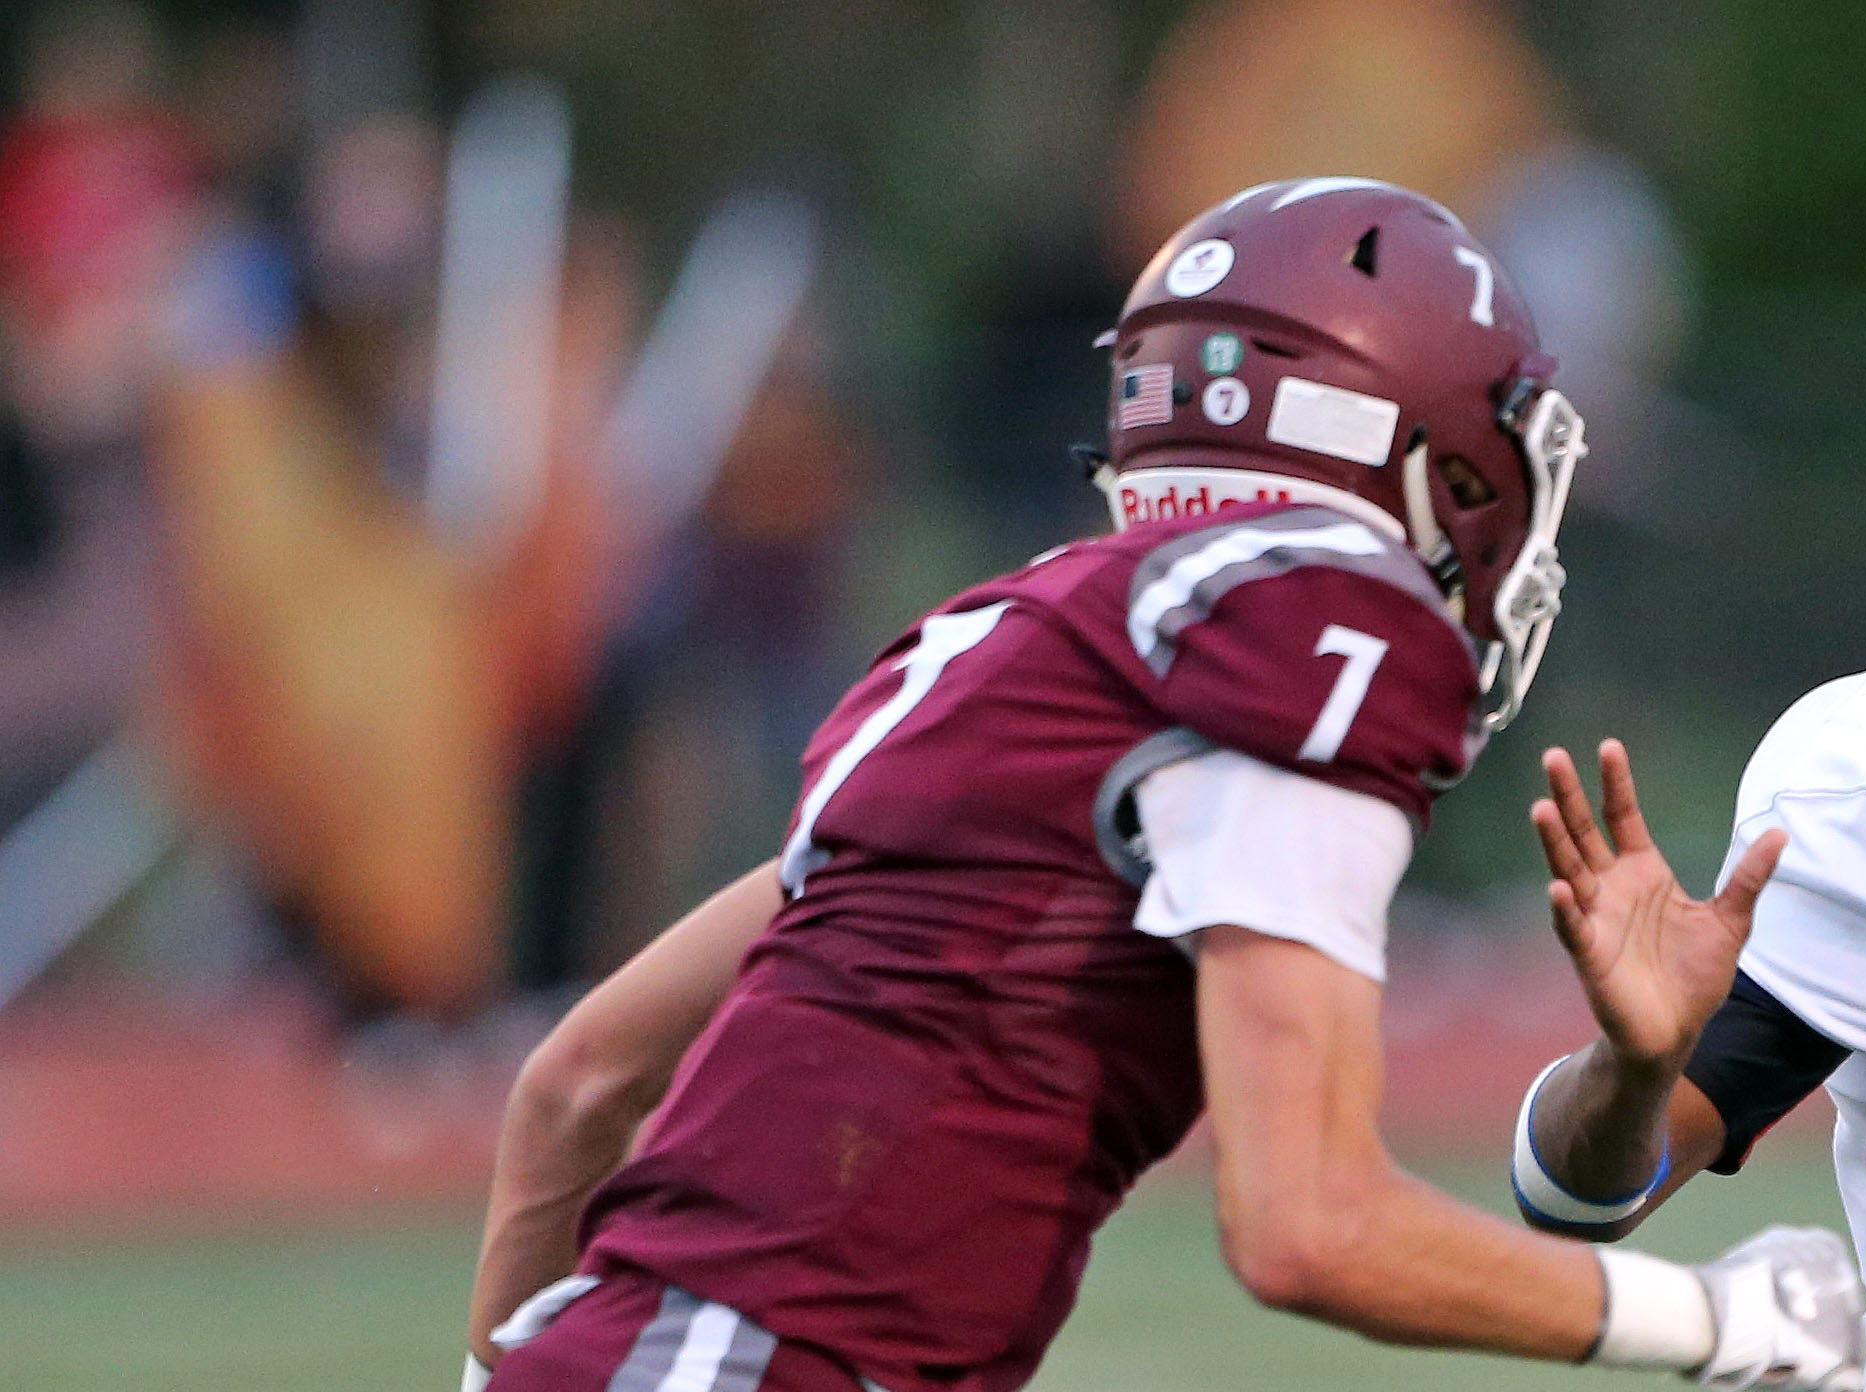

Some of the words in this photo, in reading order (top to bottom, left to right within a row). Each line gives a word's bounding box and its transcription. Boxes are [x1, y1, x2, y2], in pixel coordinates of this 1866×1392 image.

[1455, 246, 1494, 326] 7
[1120, 486, 1290, 524] Ridd
[1300, 624, 1389, 763] 7
